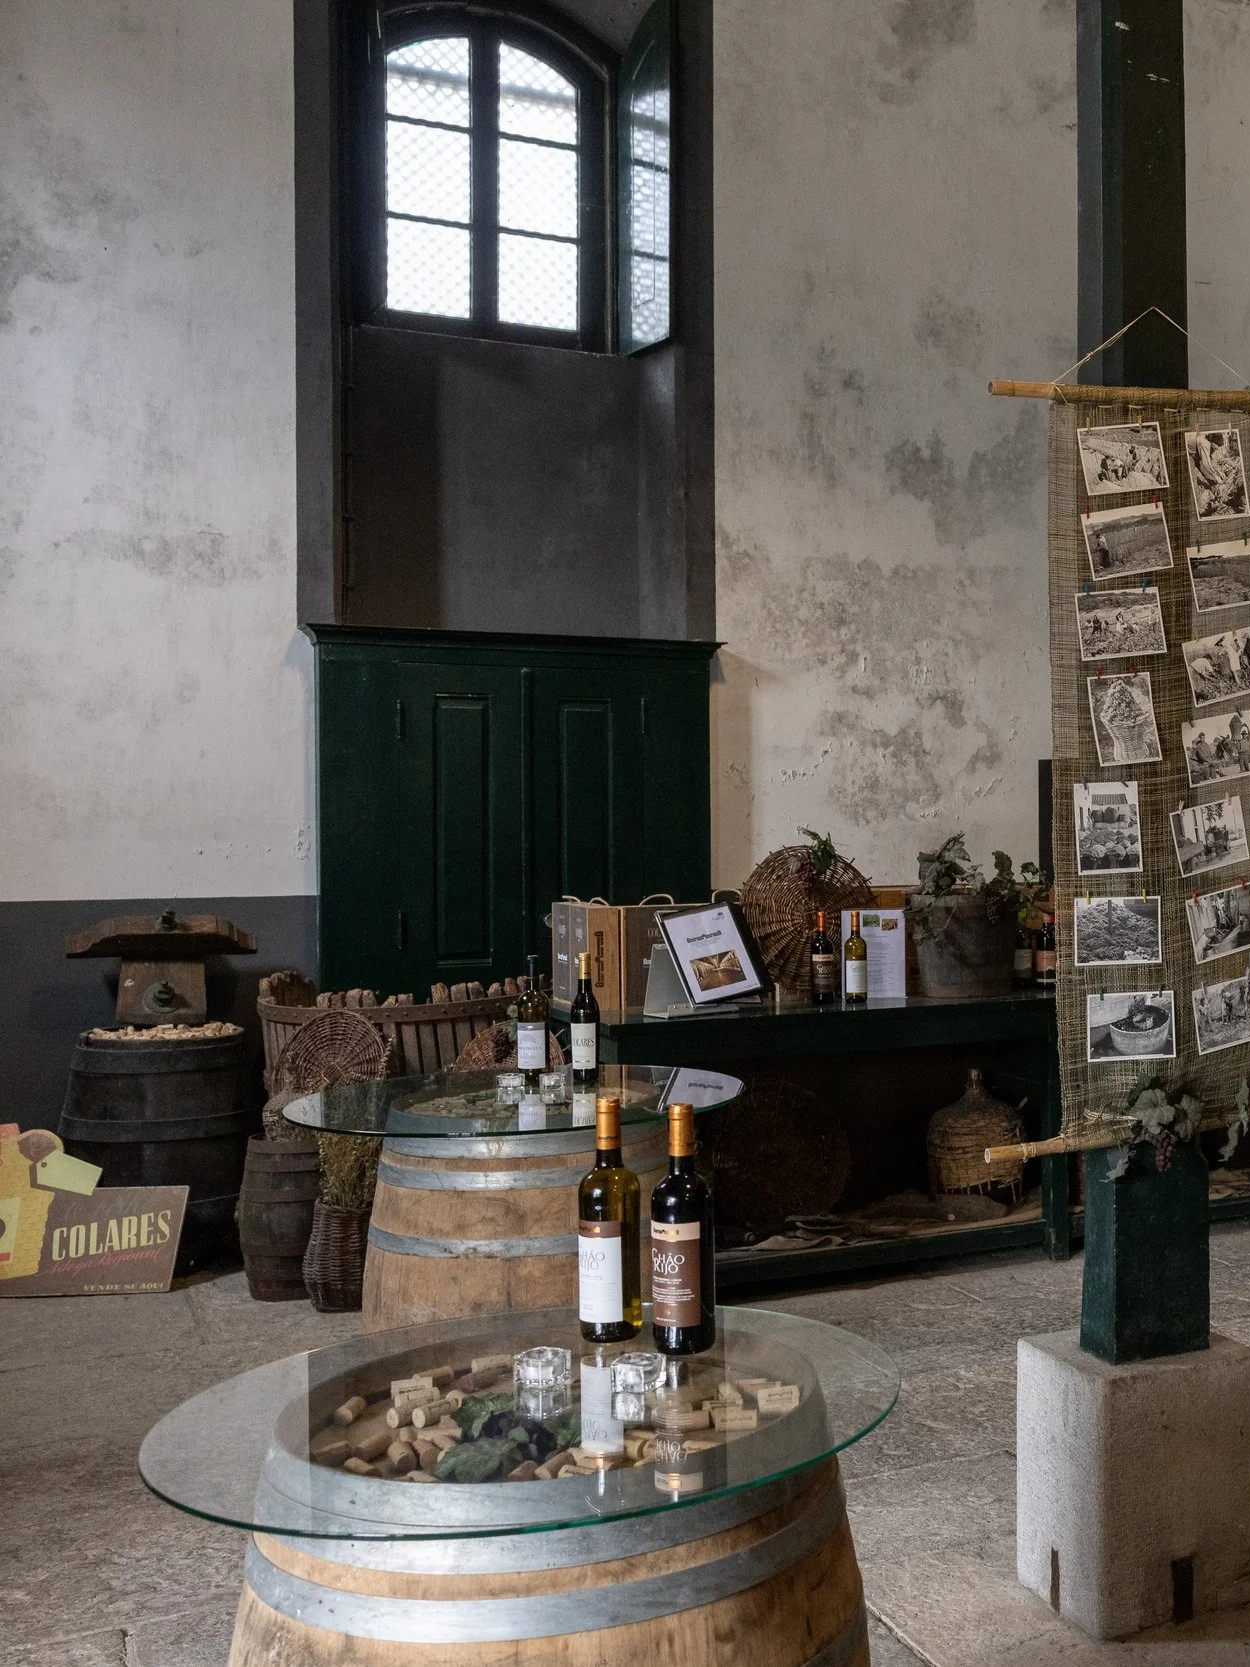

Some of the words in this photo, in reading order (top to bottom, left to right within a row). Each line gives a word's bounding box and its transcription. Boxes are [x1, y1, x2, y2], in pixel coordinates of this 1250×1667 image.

[52, 1210, 171, 1261] COLARES
[651, 1247, 685, 1265] CHÃO
[653, 1257, 678, 1275] RIJO
[83, 1284, 121, 1292] VENDE
[124, 1283, 137, 1291] SE
[138, 1282, 164, 1290] AQUI
